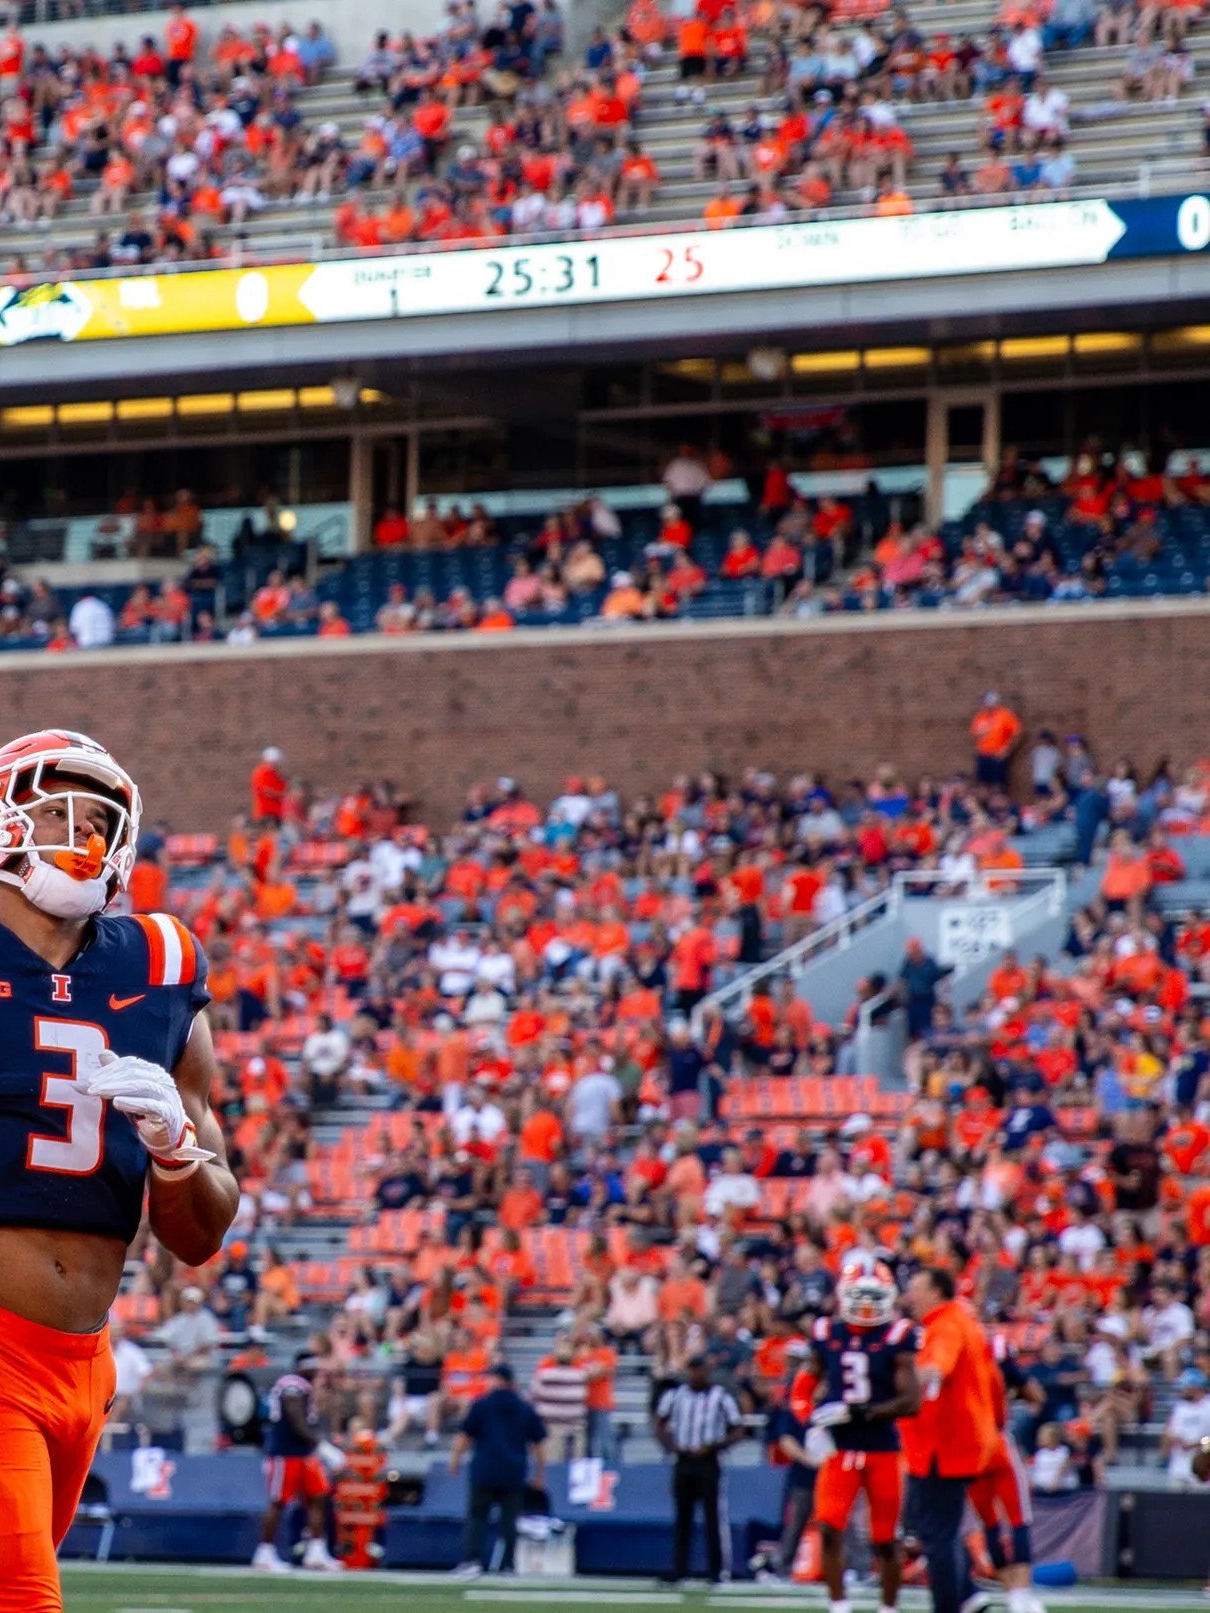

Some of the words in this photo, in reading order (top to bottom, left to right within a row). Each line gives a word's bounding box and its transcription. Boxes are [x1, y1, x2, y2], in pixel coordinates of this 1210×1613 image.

[1177, 194, 1210, 251] 0
[485, 255, 602, 296] 25:31
[655, 245, 704, 283] 25
[51, 973, 72, 1002] I
[24, 1015, 110, 1177] 3
[841, 1351, 872, 1404] 3
